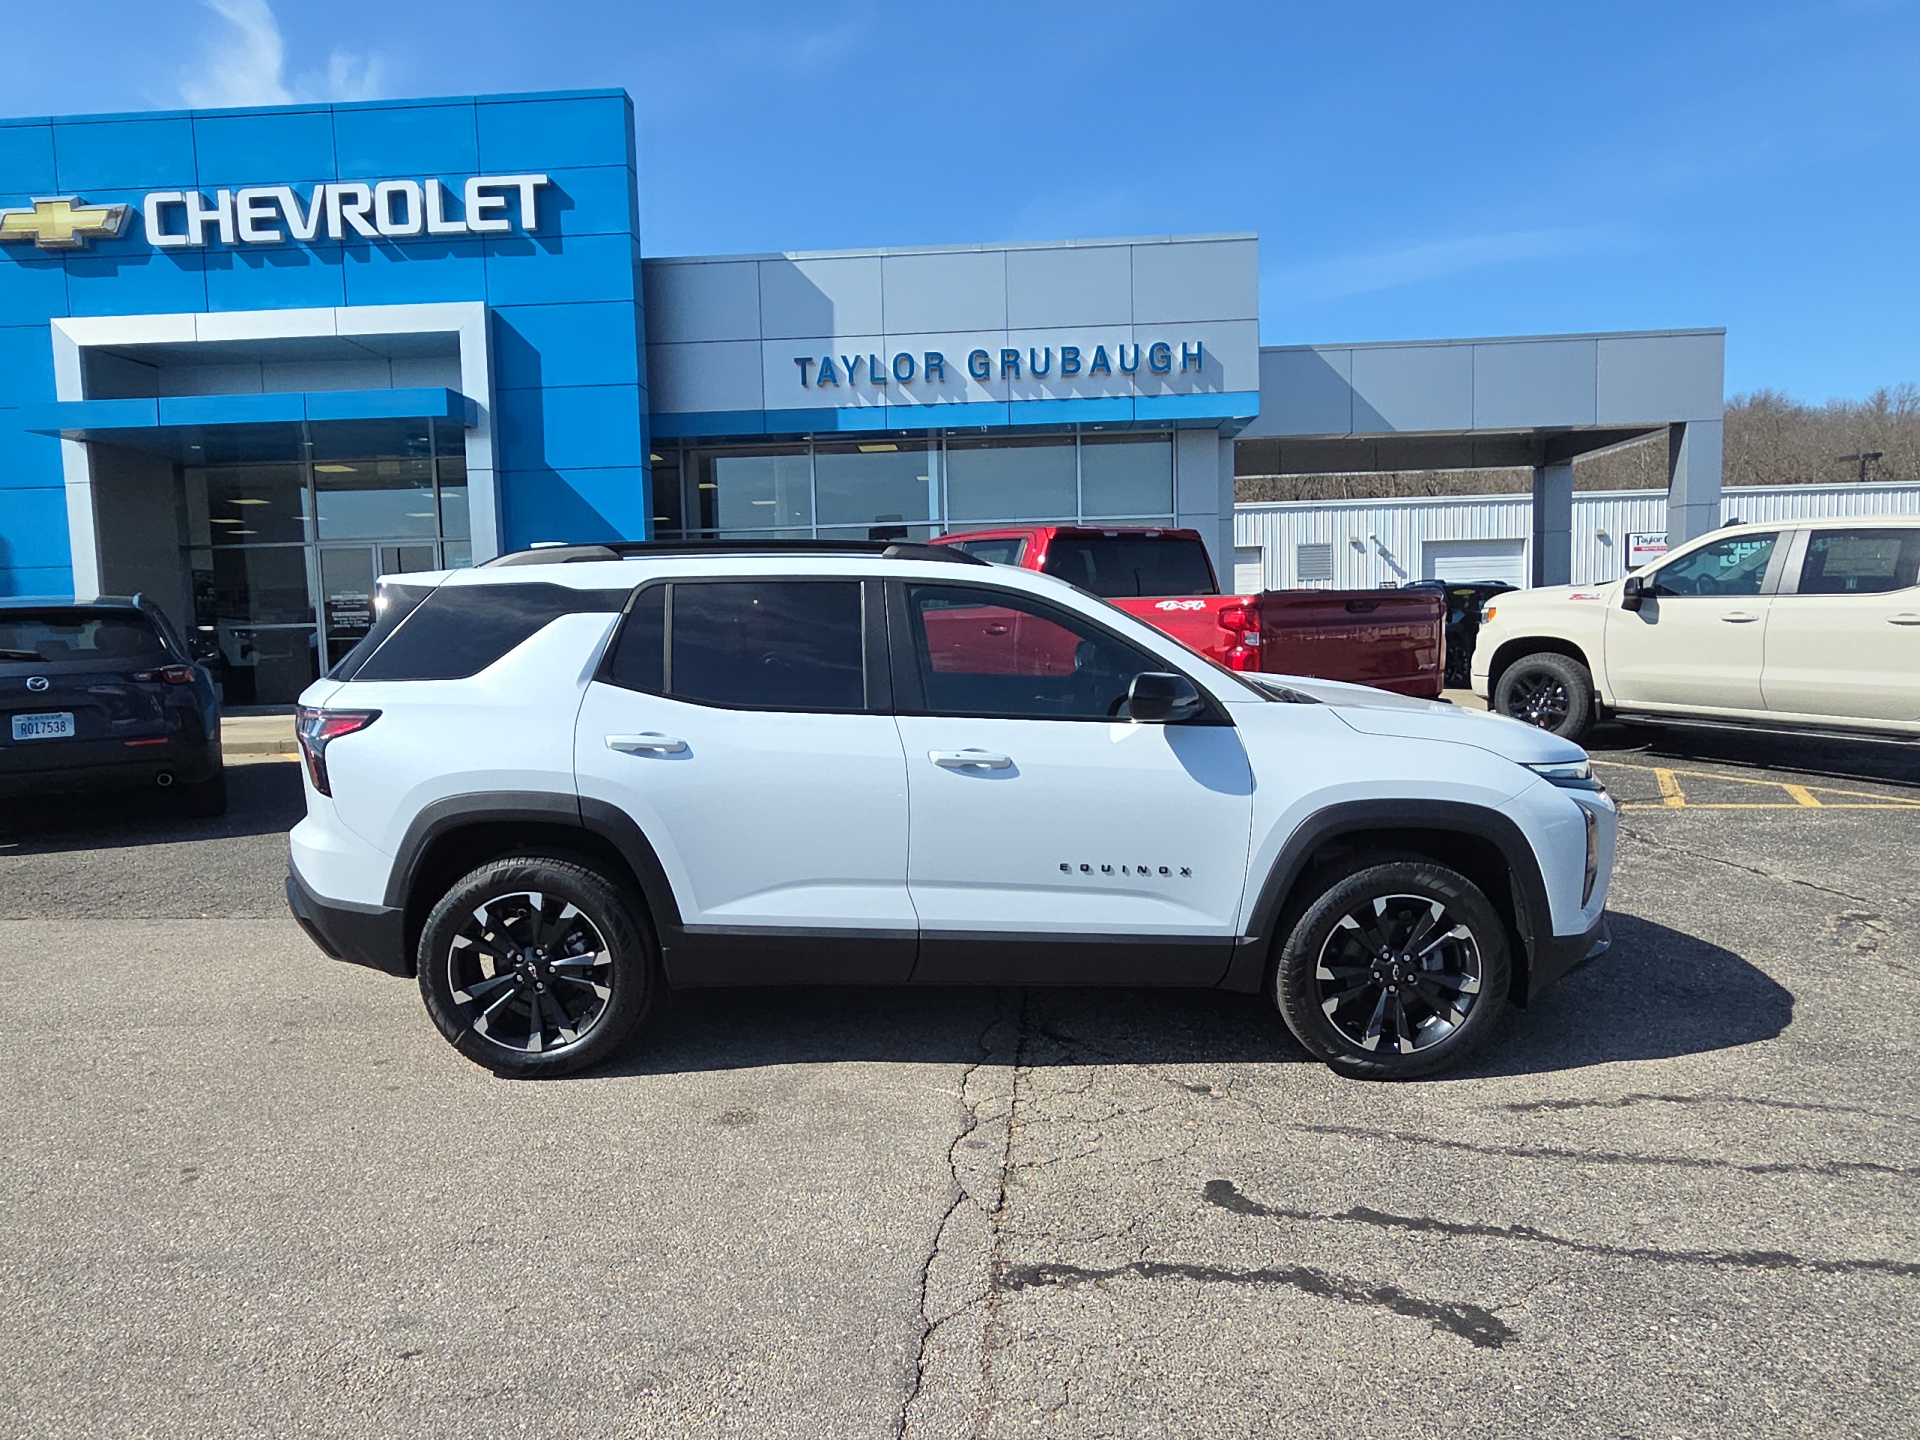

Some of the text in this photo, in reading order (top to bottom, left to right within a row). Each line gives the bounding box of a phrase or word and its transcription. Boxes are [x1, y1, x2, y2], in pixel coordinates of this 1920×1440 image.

[144, 174, 548, 247] CHEVROLET
[793, 341, 1203, 387] TAYLOR GRUBAUGH
[1633, 535, 1663, 545] Taylor
[1059, 863, 1190, 876] EQUINOX
